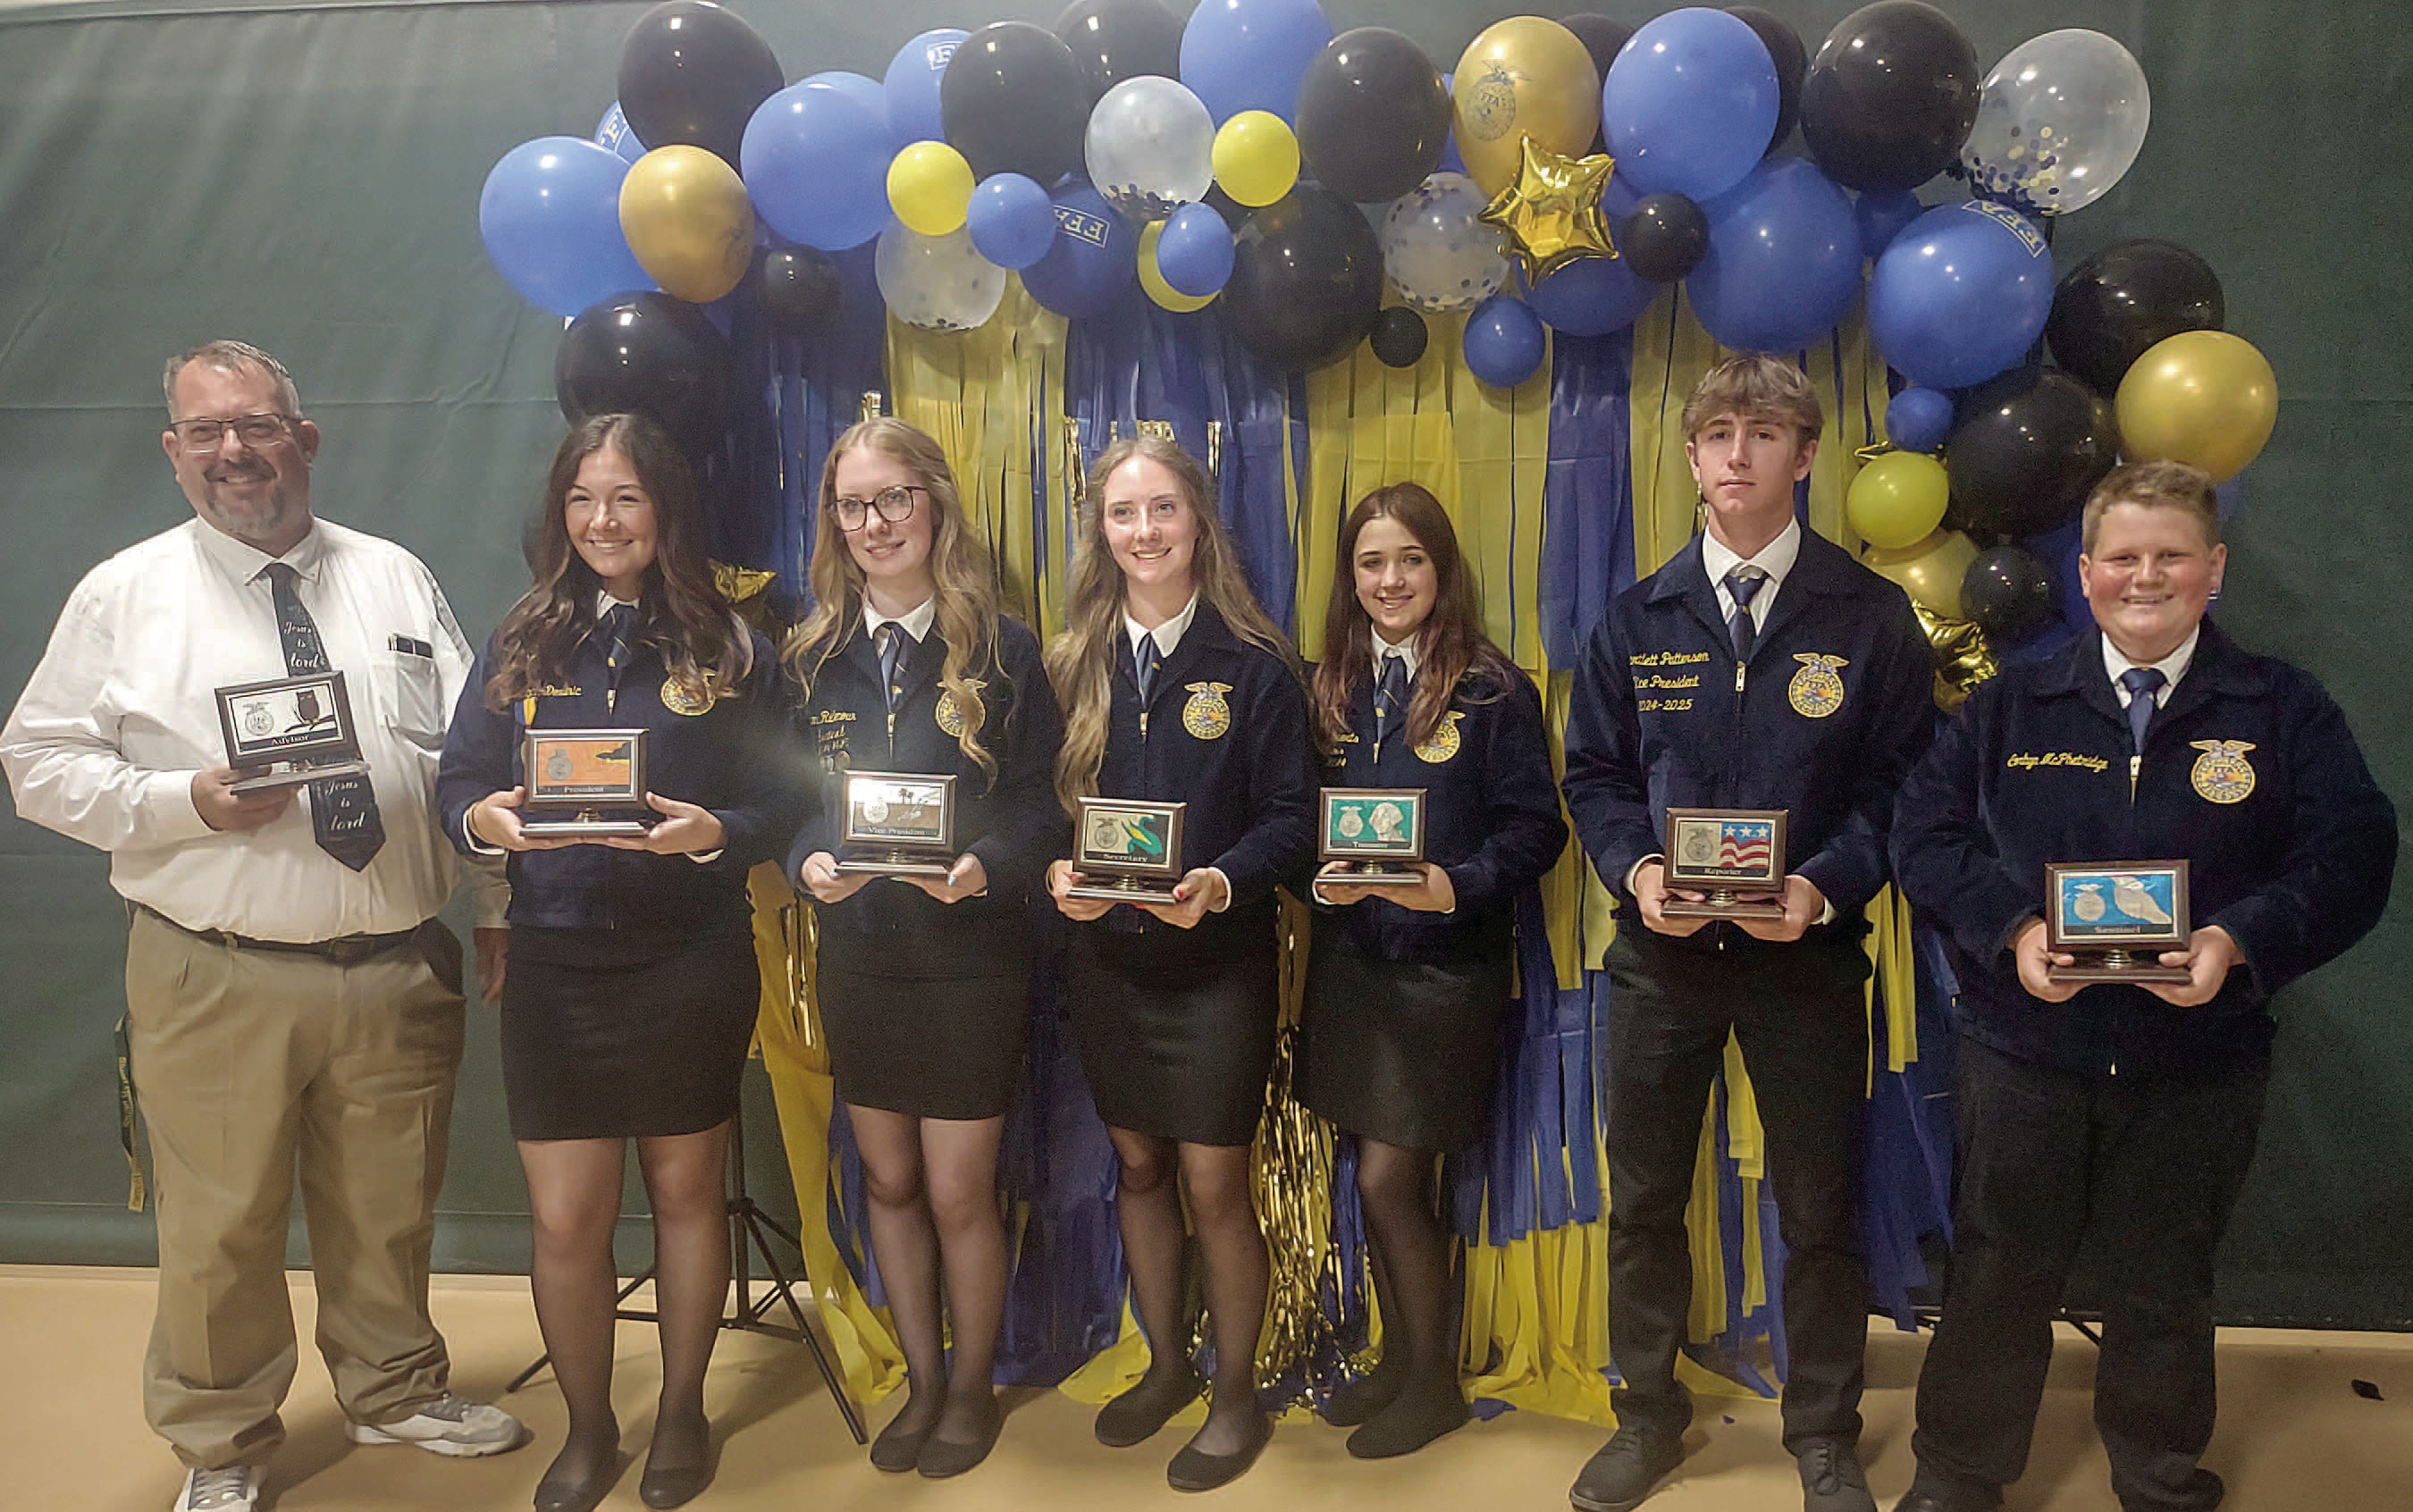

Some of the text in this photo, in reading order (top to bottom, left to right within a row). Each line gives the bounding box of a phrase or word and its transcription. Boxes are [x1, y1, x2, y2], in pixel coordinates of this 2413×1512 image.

[1981, 201, 2039, 249] FFA
[297, 637, 307, 648] is
[1649, 674, 1700, 689] President
[272, 735, 309, 746] Advisor
[341, 797, 350, 808] is
[1103, 853, 1148, 863] Secretary
